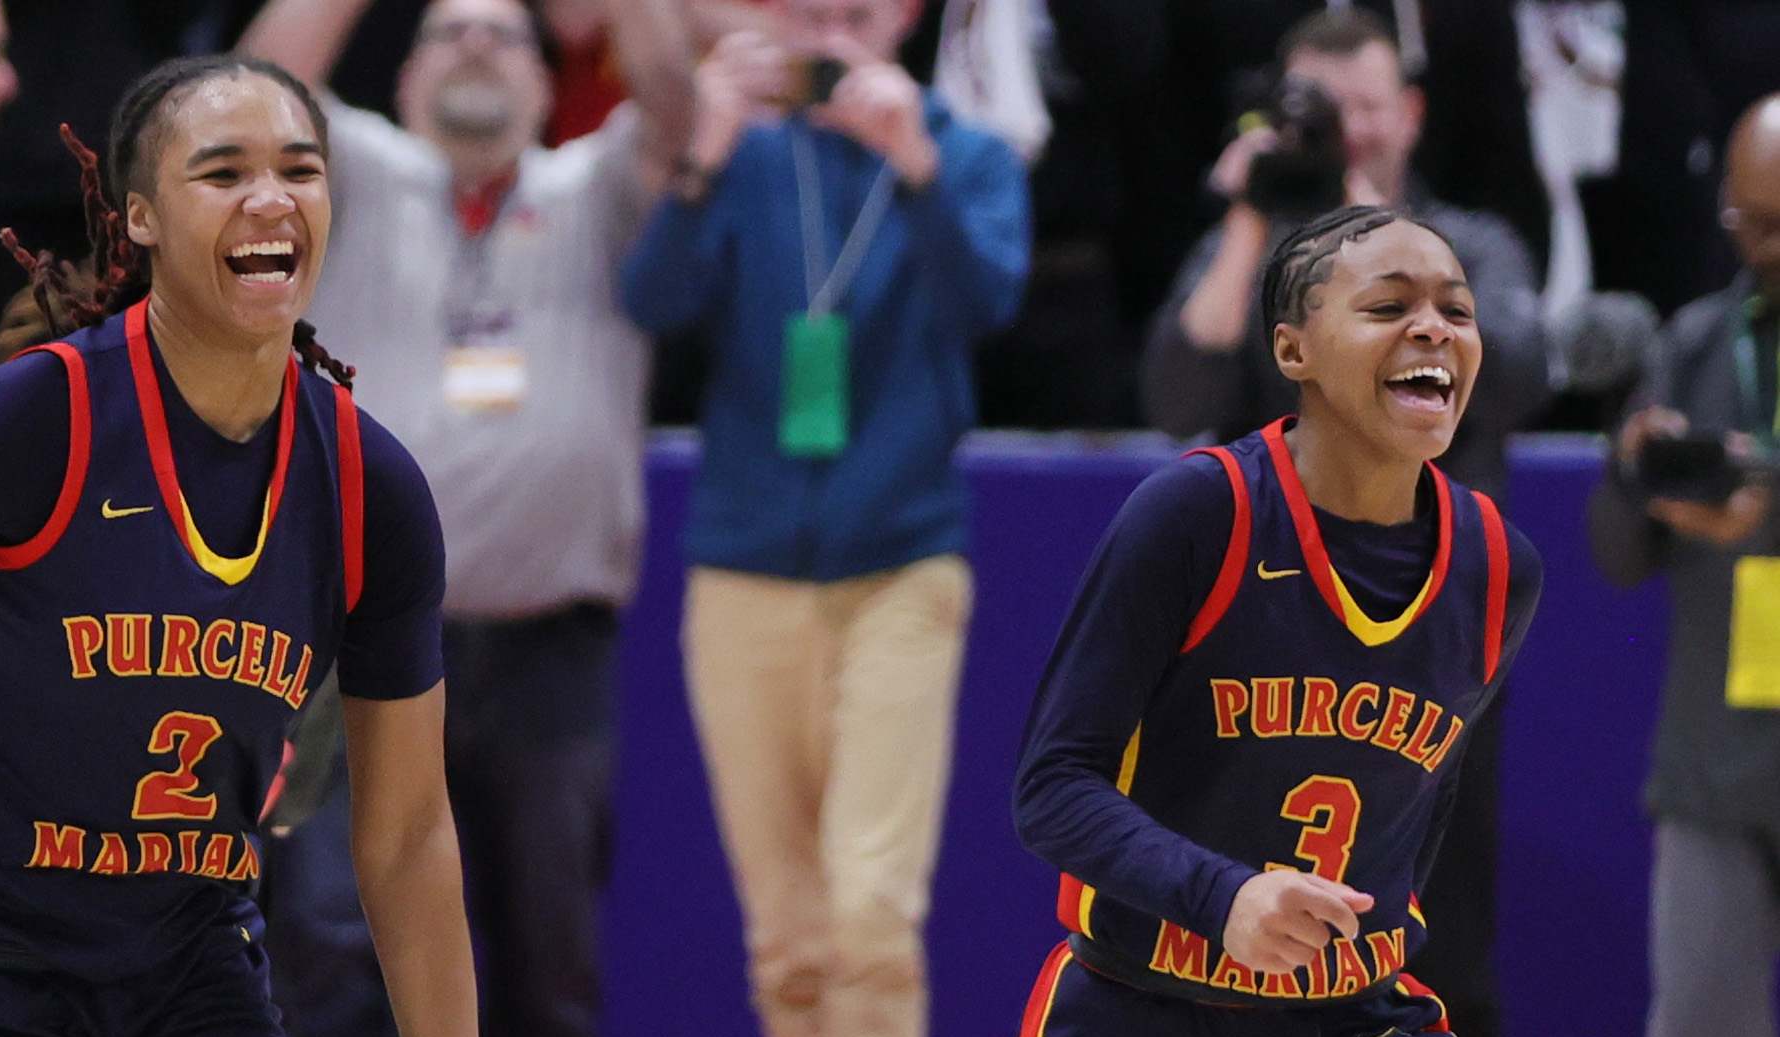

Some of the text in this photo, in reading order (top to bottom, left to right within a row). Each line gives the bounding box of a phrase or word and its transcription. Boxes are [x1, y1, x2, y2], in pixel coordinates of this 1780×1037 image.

[62, 613, 313, 711] PURCELL
[131, 710, 223, 820] 2
[1210, 676, 1464, 773] PURCELL
[1265, 774, 1361, 883] 3
